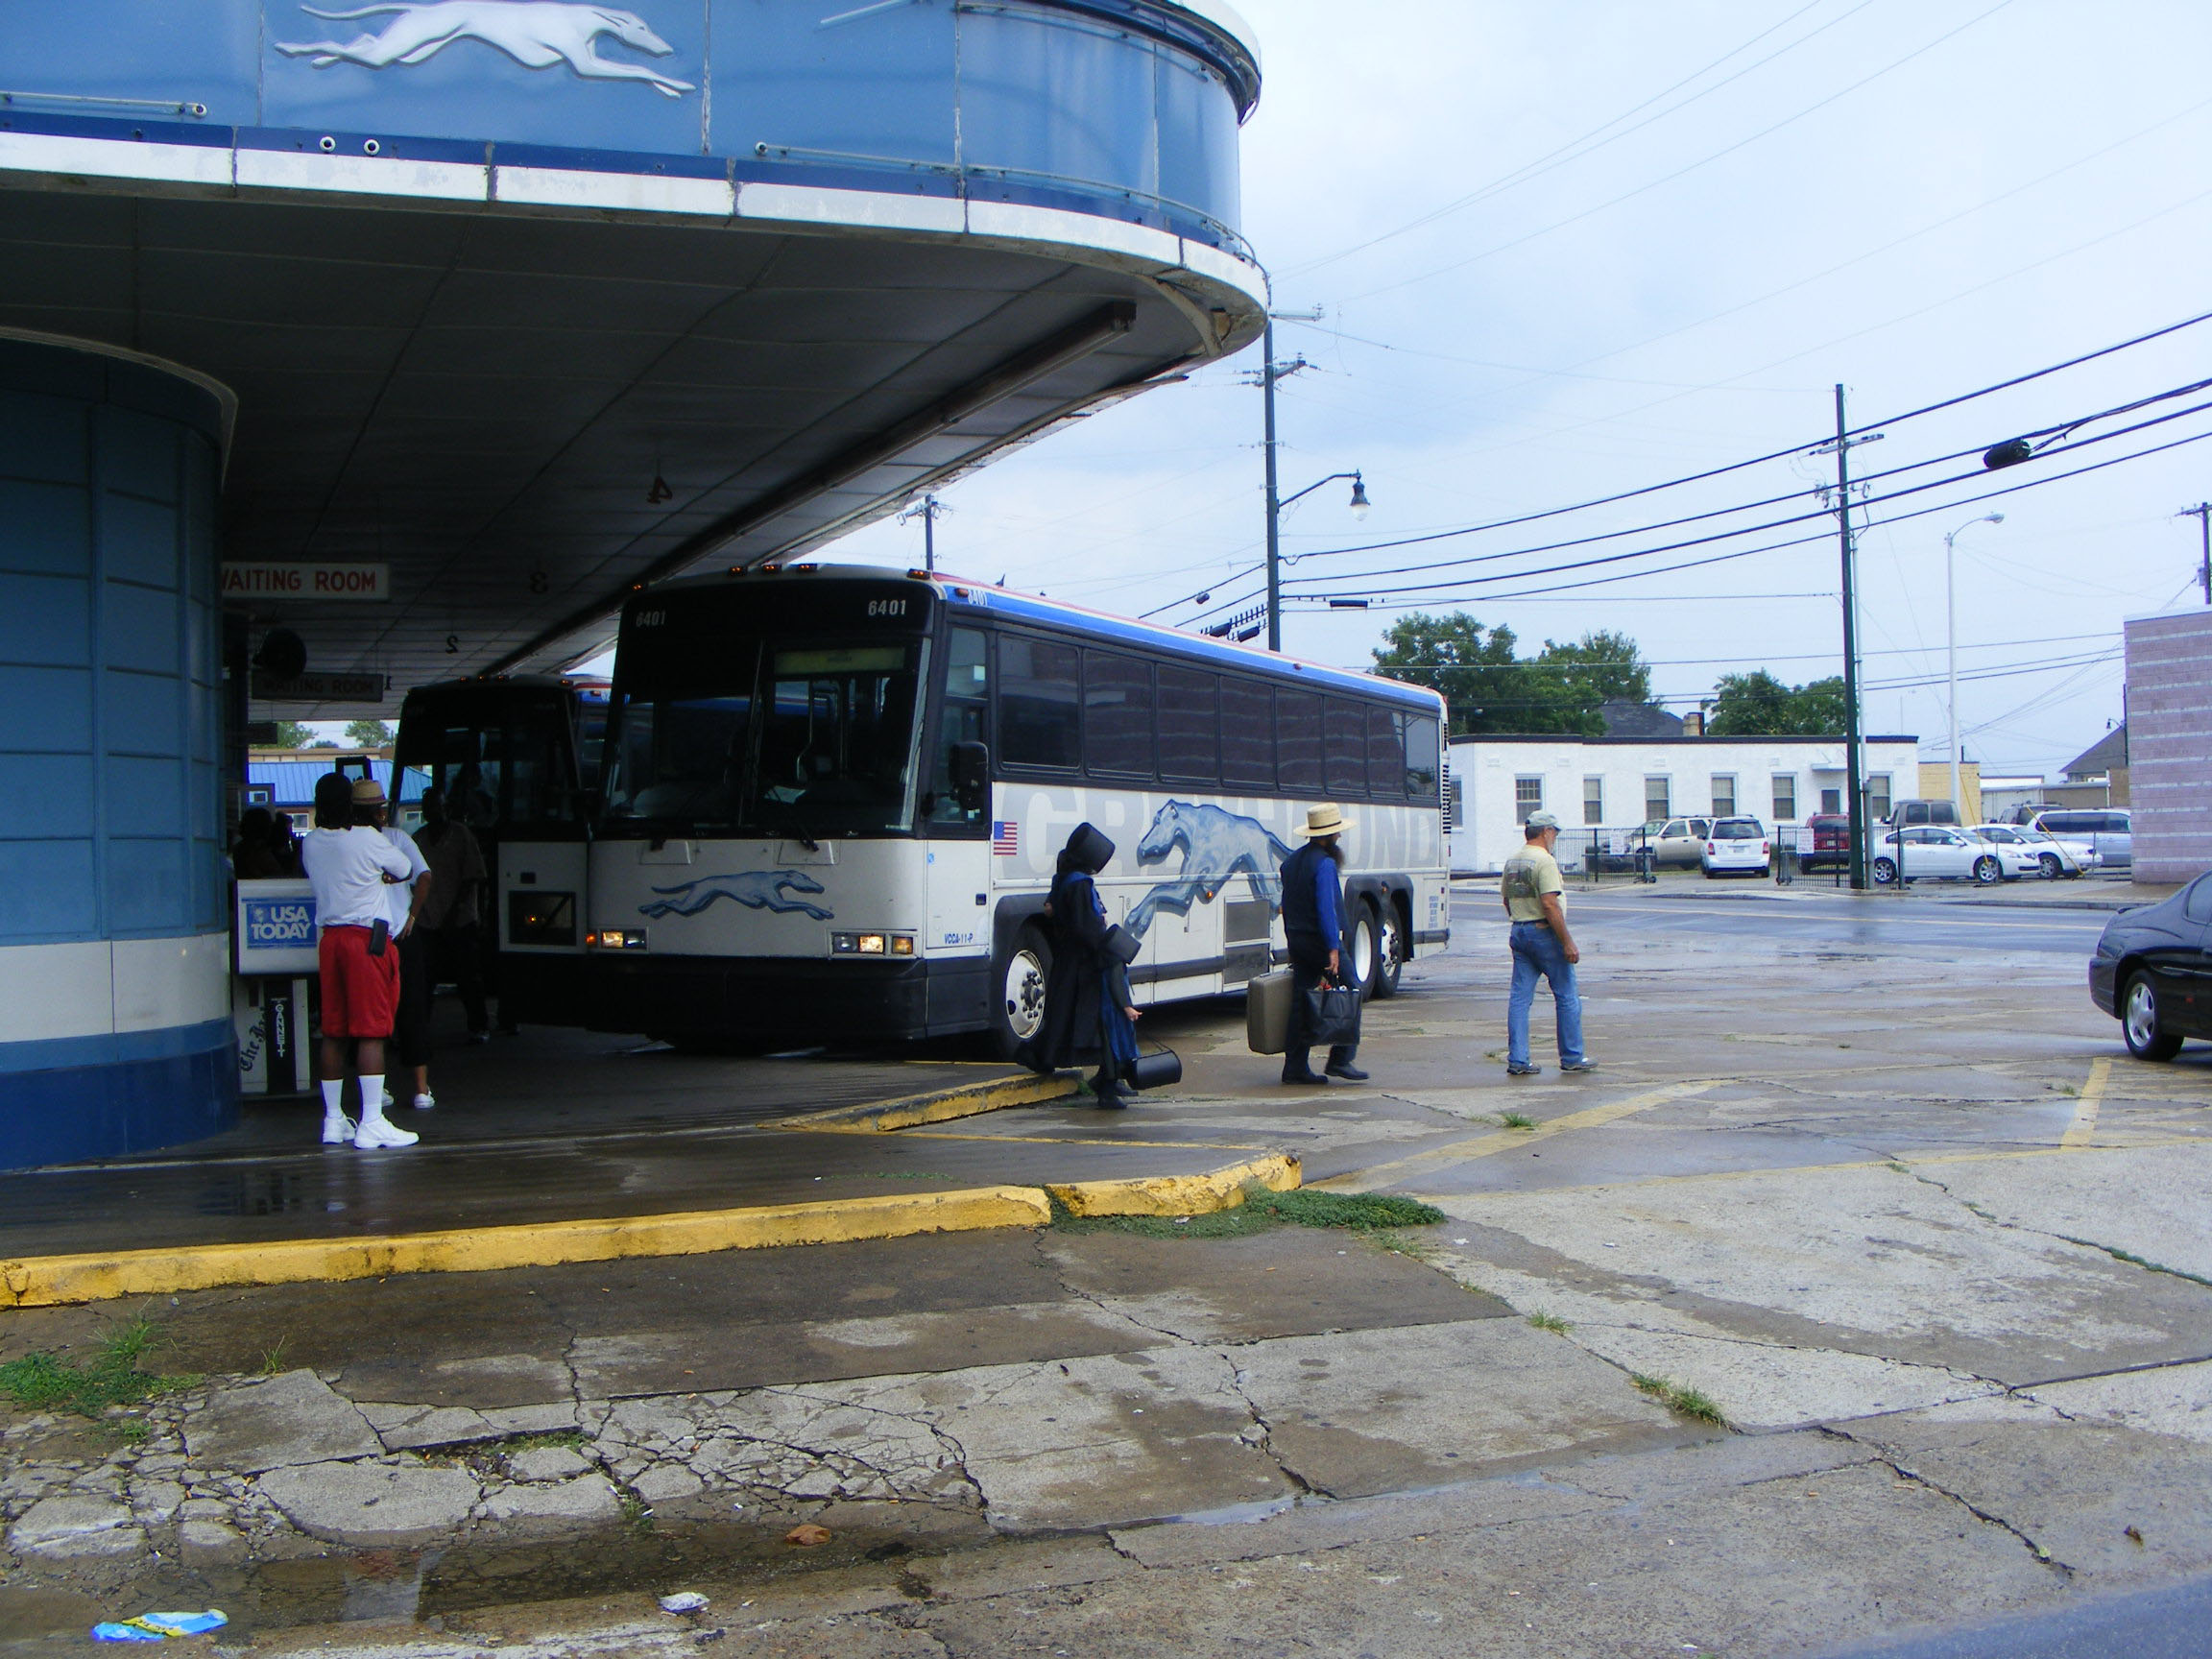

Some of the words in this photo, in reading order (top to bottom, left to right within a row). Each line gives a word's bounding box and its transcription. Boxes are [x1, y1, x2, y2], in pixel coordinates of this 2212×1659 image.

[221, 568, 301, 591] AITING
[315, 570, 376, 591] ROOM
[868, 599, 906, 615] 6401
[636, 610, 666, 627] 6401
[270, 905, 309, 922] USA
[251, 923, 311, 941] TODAY
